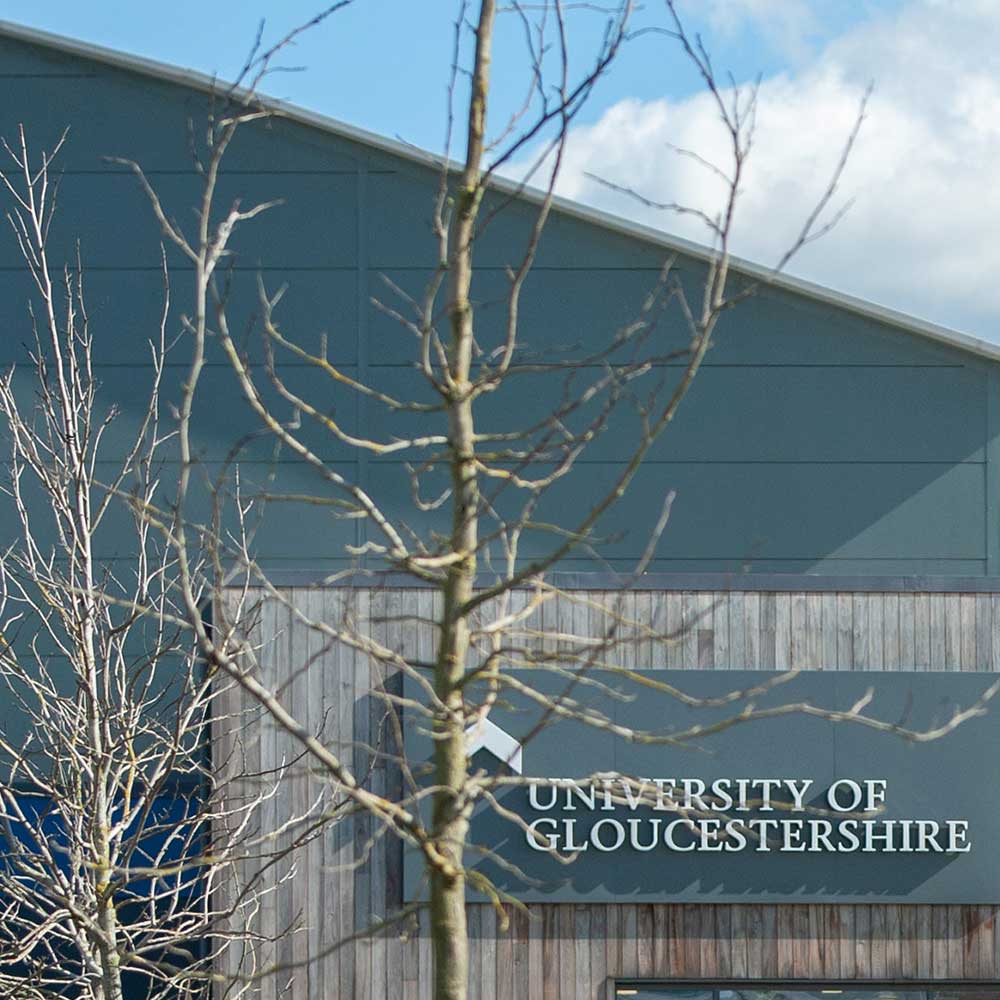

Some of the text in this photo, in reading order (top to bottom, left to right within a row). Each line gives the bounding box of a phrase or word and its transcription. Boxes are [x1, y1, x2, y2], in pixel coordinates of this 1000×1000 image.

[527, 778, 887, 812] UNIVERSITY OF
[526, 817, 972, 853] GLOUCESTERSHIRE
